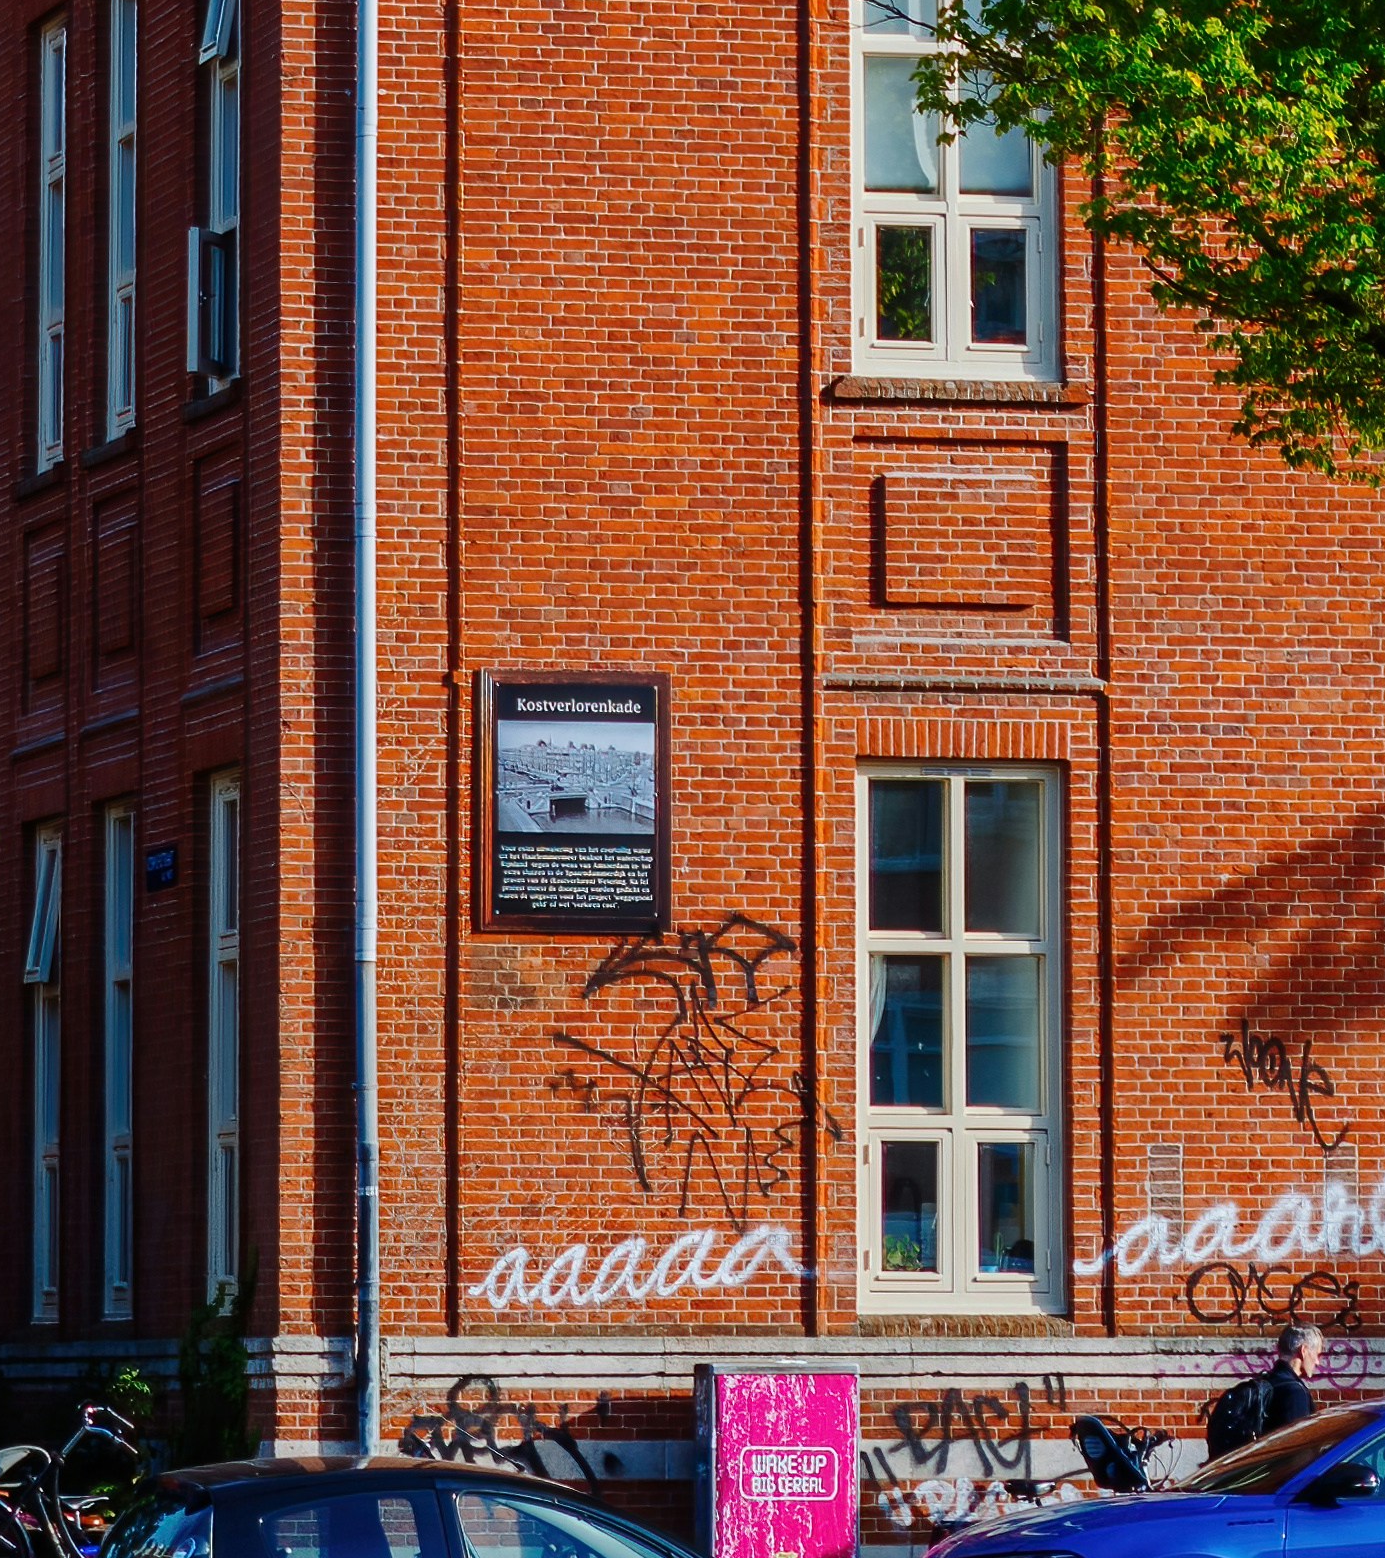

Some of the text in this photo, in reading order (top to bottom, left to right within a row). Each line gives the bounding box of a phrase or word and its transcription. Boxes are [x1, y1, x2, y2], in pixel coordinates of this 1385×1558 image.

[517, 698, 641, 714] Kostverlorenkade
[752, 1476, 826, 1493] BIG CEREAL
